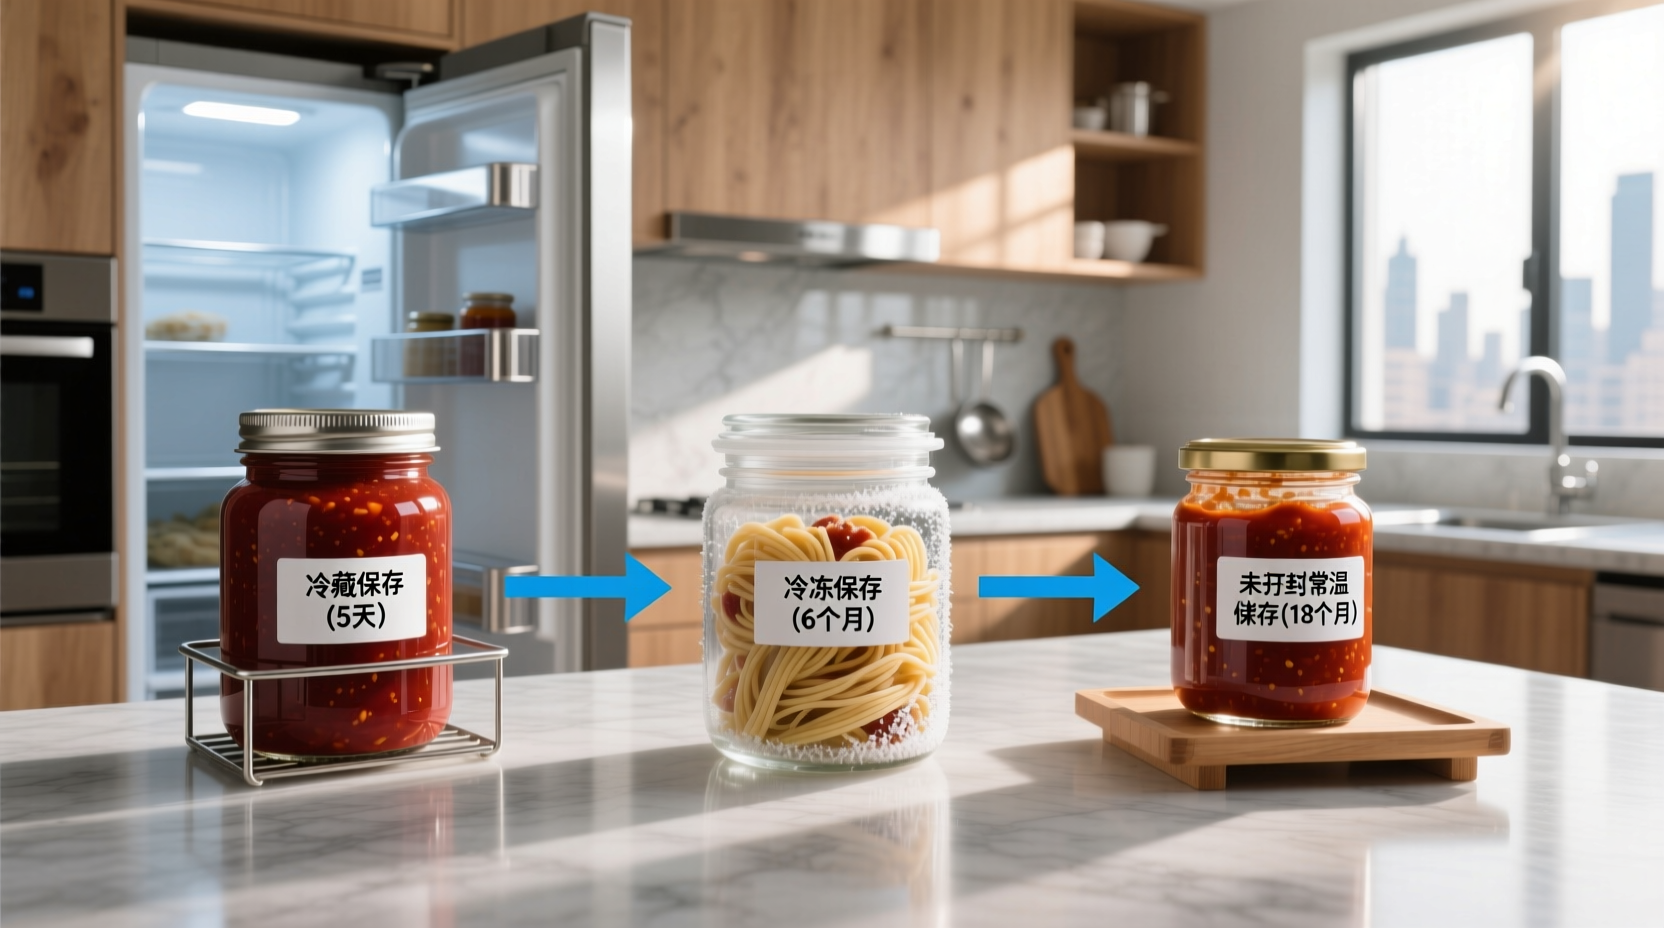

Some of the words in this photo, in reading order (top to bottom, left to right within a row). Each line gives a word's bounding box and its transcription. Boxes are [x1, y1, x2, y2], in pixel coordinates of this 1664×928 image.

[305, 569, 404, 599] 冷藏保存
[784, 574, 882, 601] 冷冻保存
[327, 601, 386, 632] (5天)
[792, 605, 874, 633] (6个月)
